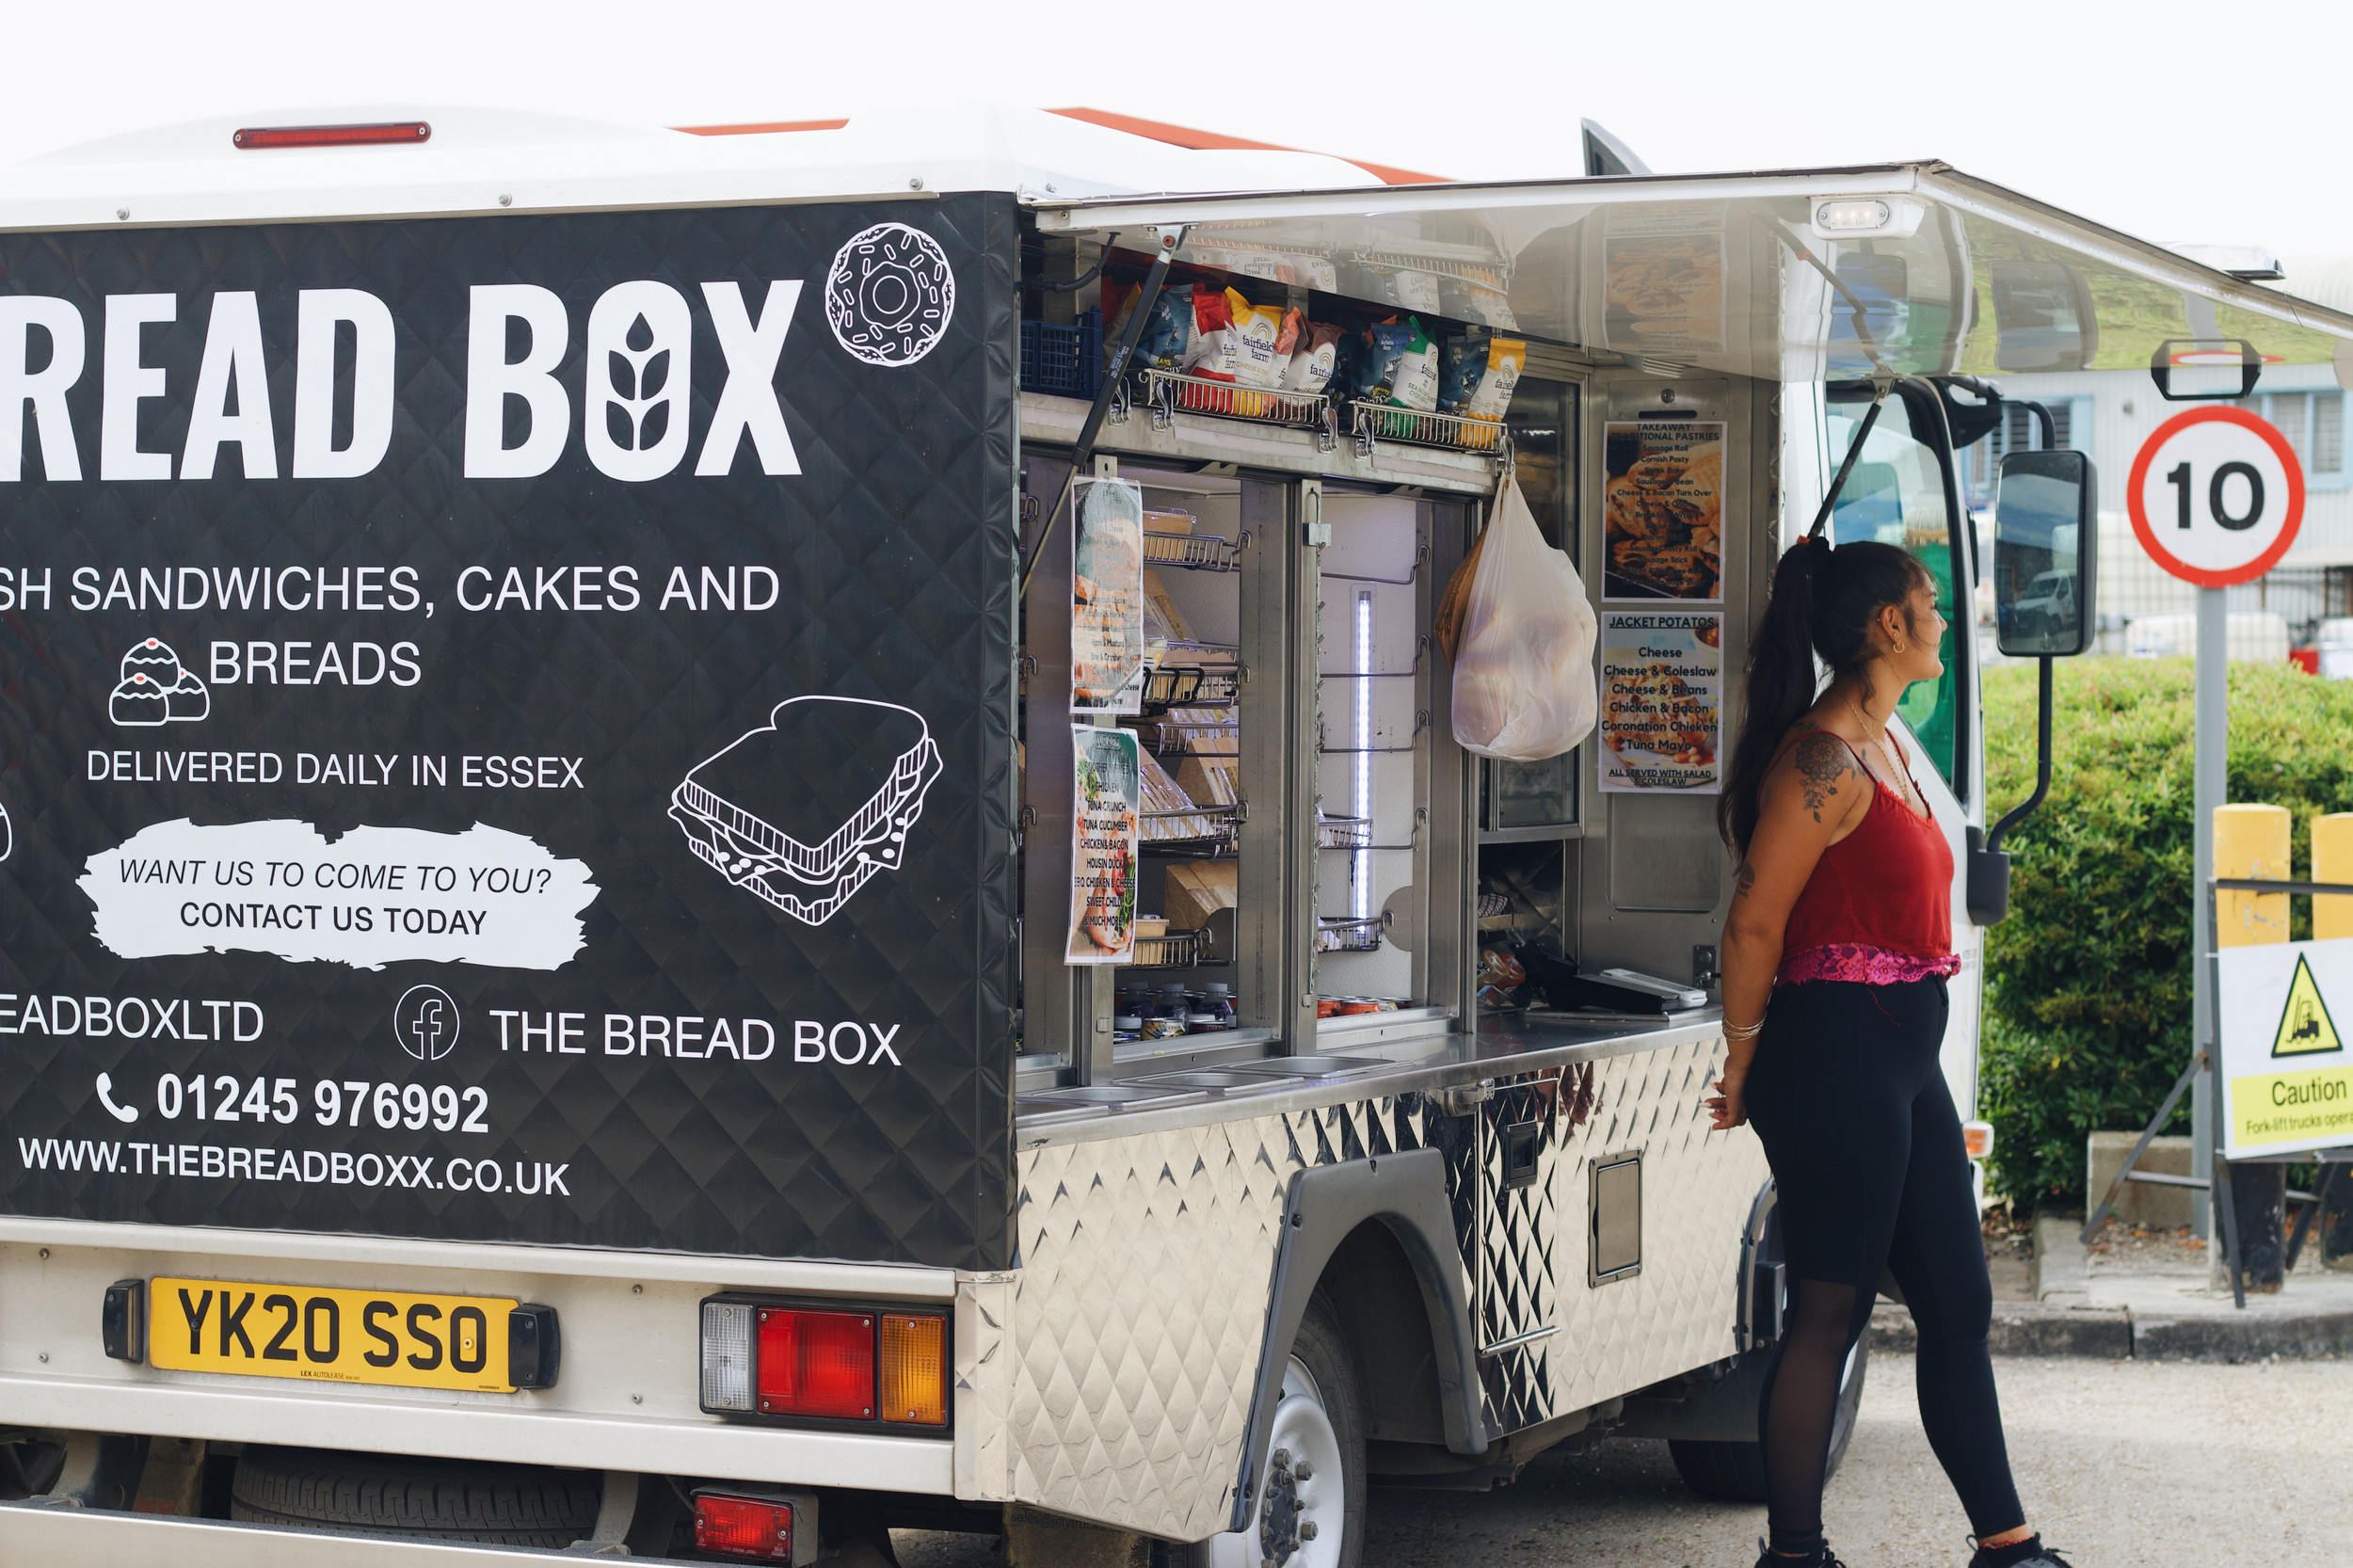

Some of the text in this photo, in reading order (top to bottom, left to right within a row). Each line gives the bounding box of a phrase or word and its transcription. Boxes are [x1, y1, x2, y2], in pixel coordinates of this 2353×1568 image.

[464, 280, 804, 482] BOX
[2168, 461, 2265, 530] 10
[72, 567, 433, 618] SANDWICHES,
[457, 566, 640, 611] CAKES
[660, 567, 778, 610] AND
[1609, 616, 1715, 628] JACKET POTATOS
[1639, 647, 1682, 658] Cheese
[210, 642, 421, 687] BREADS
[1604, 664, 1717, 677] Cheese & Coleslaw
[1612, 683, 1707, 696] Cheese & Beans
[1609, 702, 1709, 714] Chicken & Bacon
[1602, 721, 1718, 732] Coronation Chicken
[1626, 740, 1691, 752] Tuna Mayo
[88, 751, 584, 789] DELIVERED DAILY IN ESSEX
[1625, 769, 1658, 777] SERVED
[1087, 800, 1127, 812] TUNA CRUNCH
[1083, 820, 1128, 832] TUNA CUCUMBER
[1109, 840, 1128, 851] BACON
[1086, 857, 1124, 869] HOUSIN DUCK
[121, 858, 552, 894] WANT US TO COME TO YOU?
[1085, 877, 1111, 888] CHICKEN
[1086, 896, 1105, 907] SWEET
[180, 902, 488, 936] CONTACT US TODAY
[1090, 915, 1106, 926] MUCH
[488, 1009, 902, 1066] THE BREAD BOX
[2272, 1076, 2346, 1106] Caution
[158, 1074, 488, 1133] 01245 976992
[2247, 1118, 2287, 1134] Fork-lift
[2289, 1113, 2322, 1129] trucks
[19, 1137, 571, 1196] WWW.THEBREADBOXX.CO.UK
[178, 1288, 487, 1373] YK20 SSO
[313, 1371, 345, 1380] AUTOLEASE
